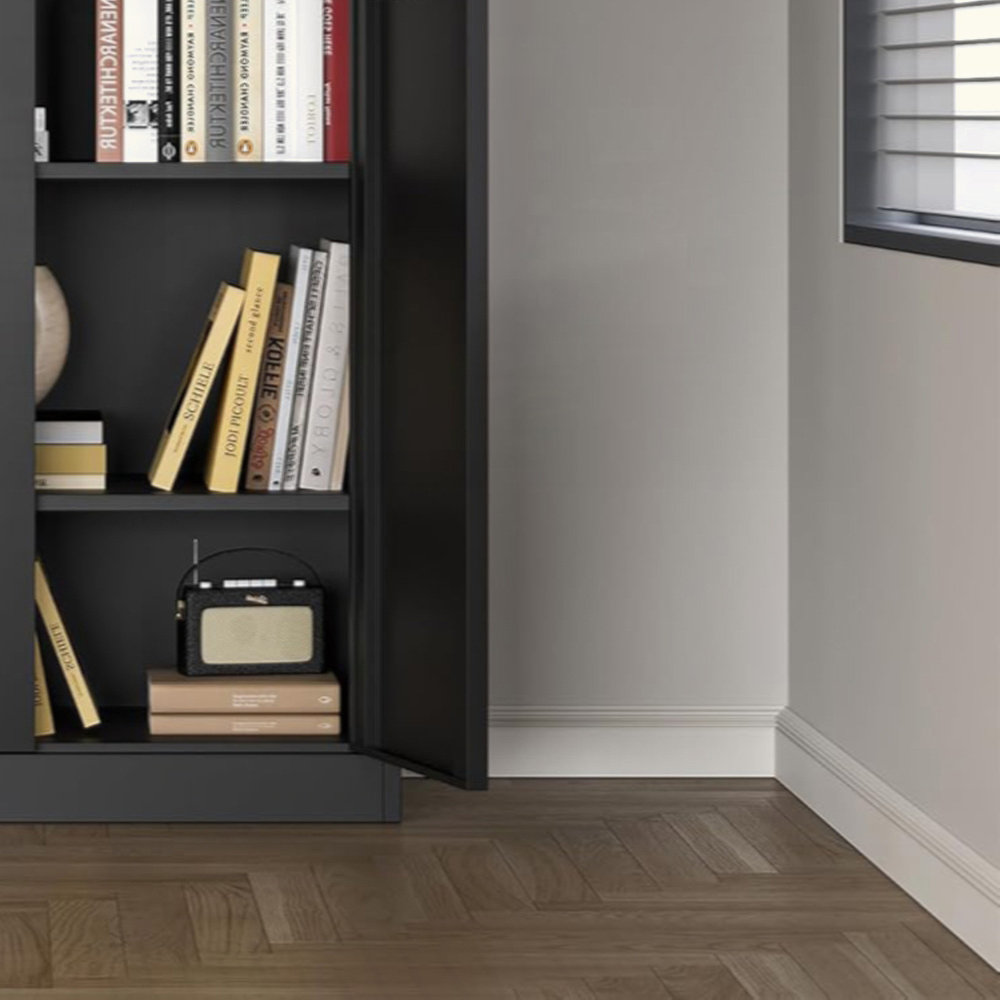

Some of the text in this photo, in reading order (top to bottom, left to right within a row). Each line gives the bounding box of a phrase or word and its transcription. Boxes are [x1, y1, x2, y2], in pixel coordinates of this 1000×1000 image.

[245, 287, 264, 353] second glance
[183, 361, 215, 422] SCHIELE
[224, 374, 249, 458] JODI PICOULT
